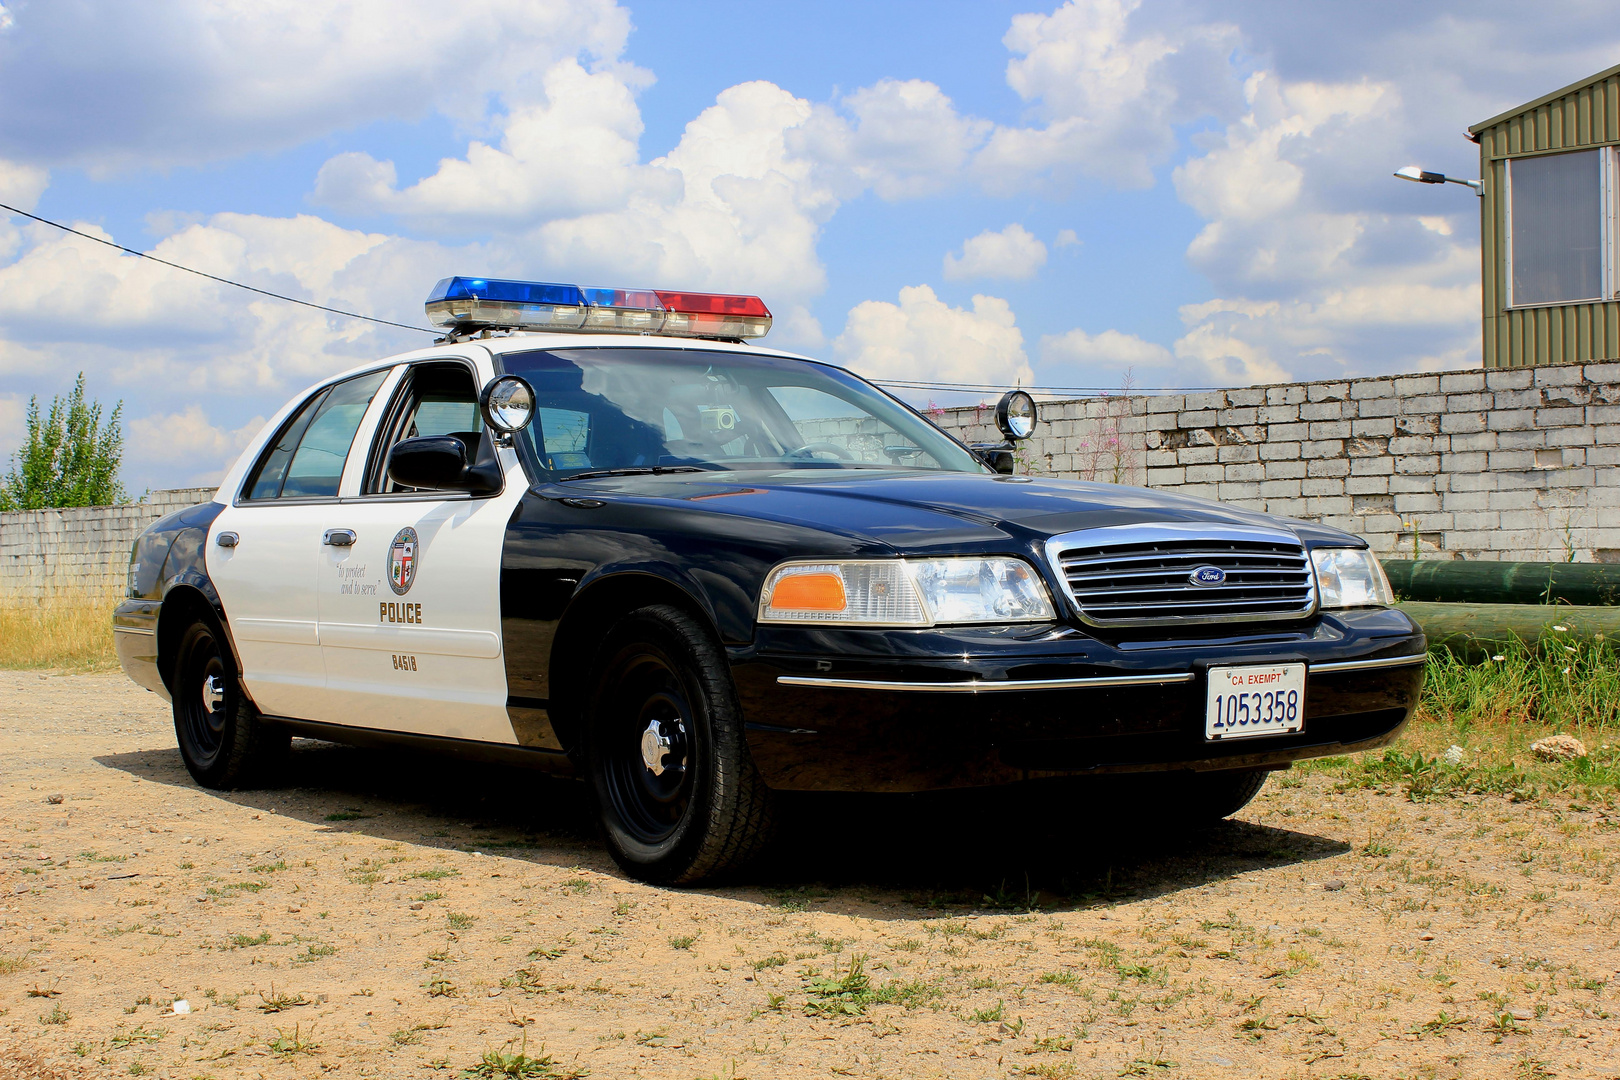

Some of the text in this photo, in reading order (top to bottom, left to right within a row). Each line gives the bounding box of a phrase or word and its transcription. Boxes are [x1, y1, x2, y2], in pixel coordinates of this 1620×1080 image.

[344, 564, 367, 581] protect
[1201, 570, 1220, 581] Ford
[340, 579, 354, 595] and
[354, 581, 361, 595] to
[379, 602, 422, 624] POLICE
[1231, 673, 1282, 686] CA EXEMPT
[1213, 689, 1298, 728] 1053358
